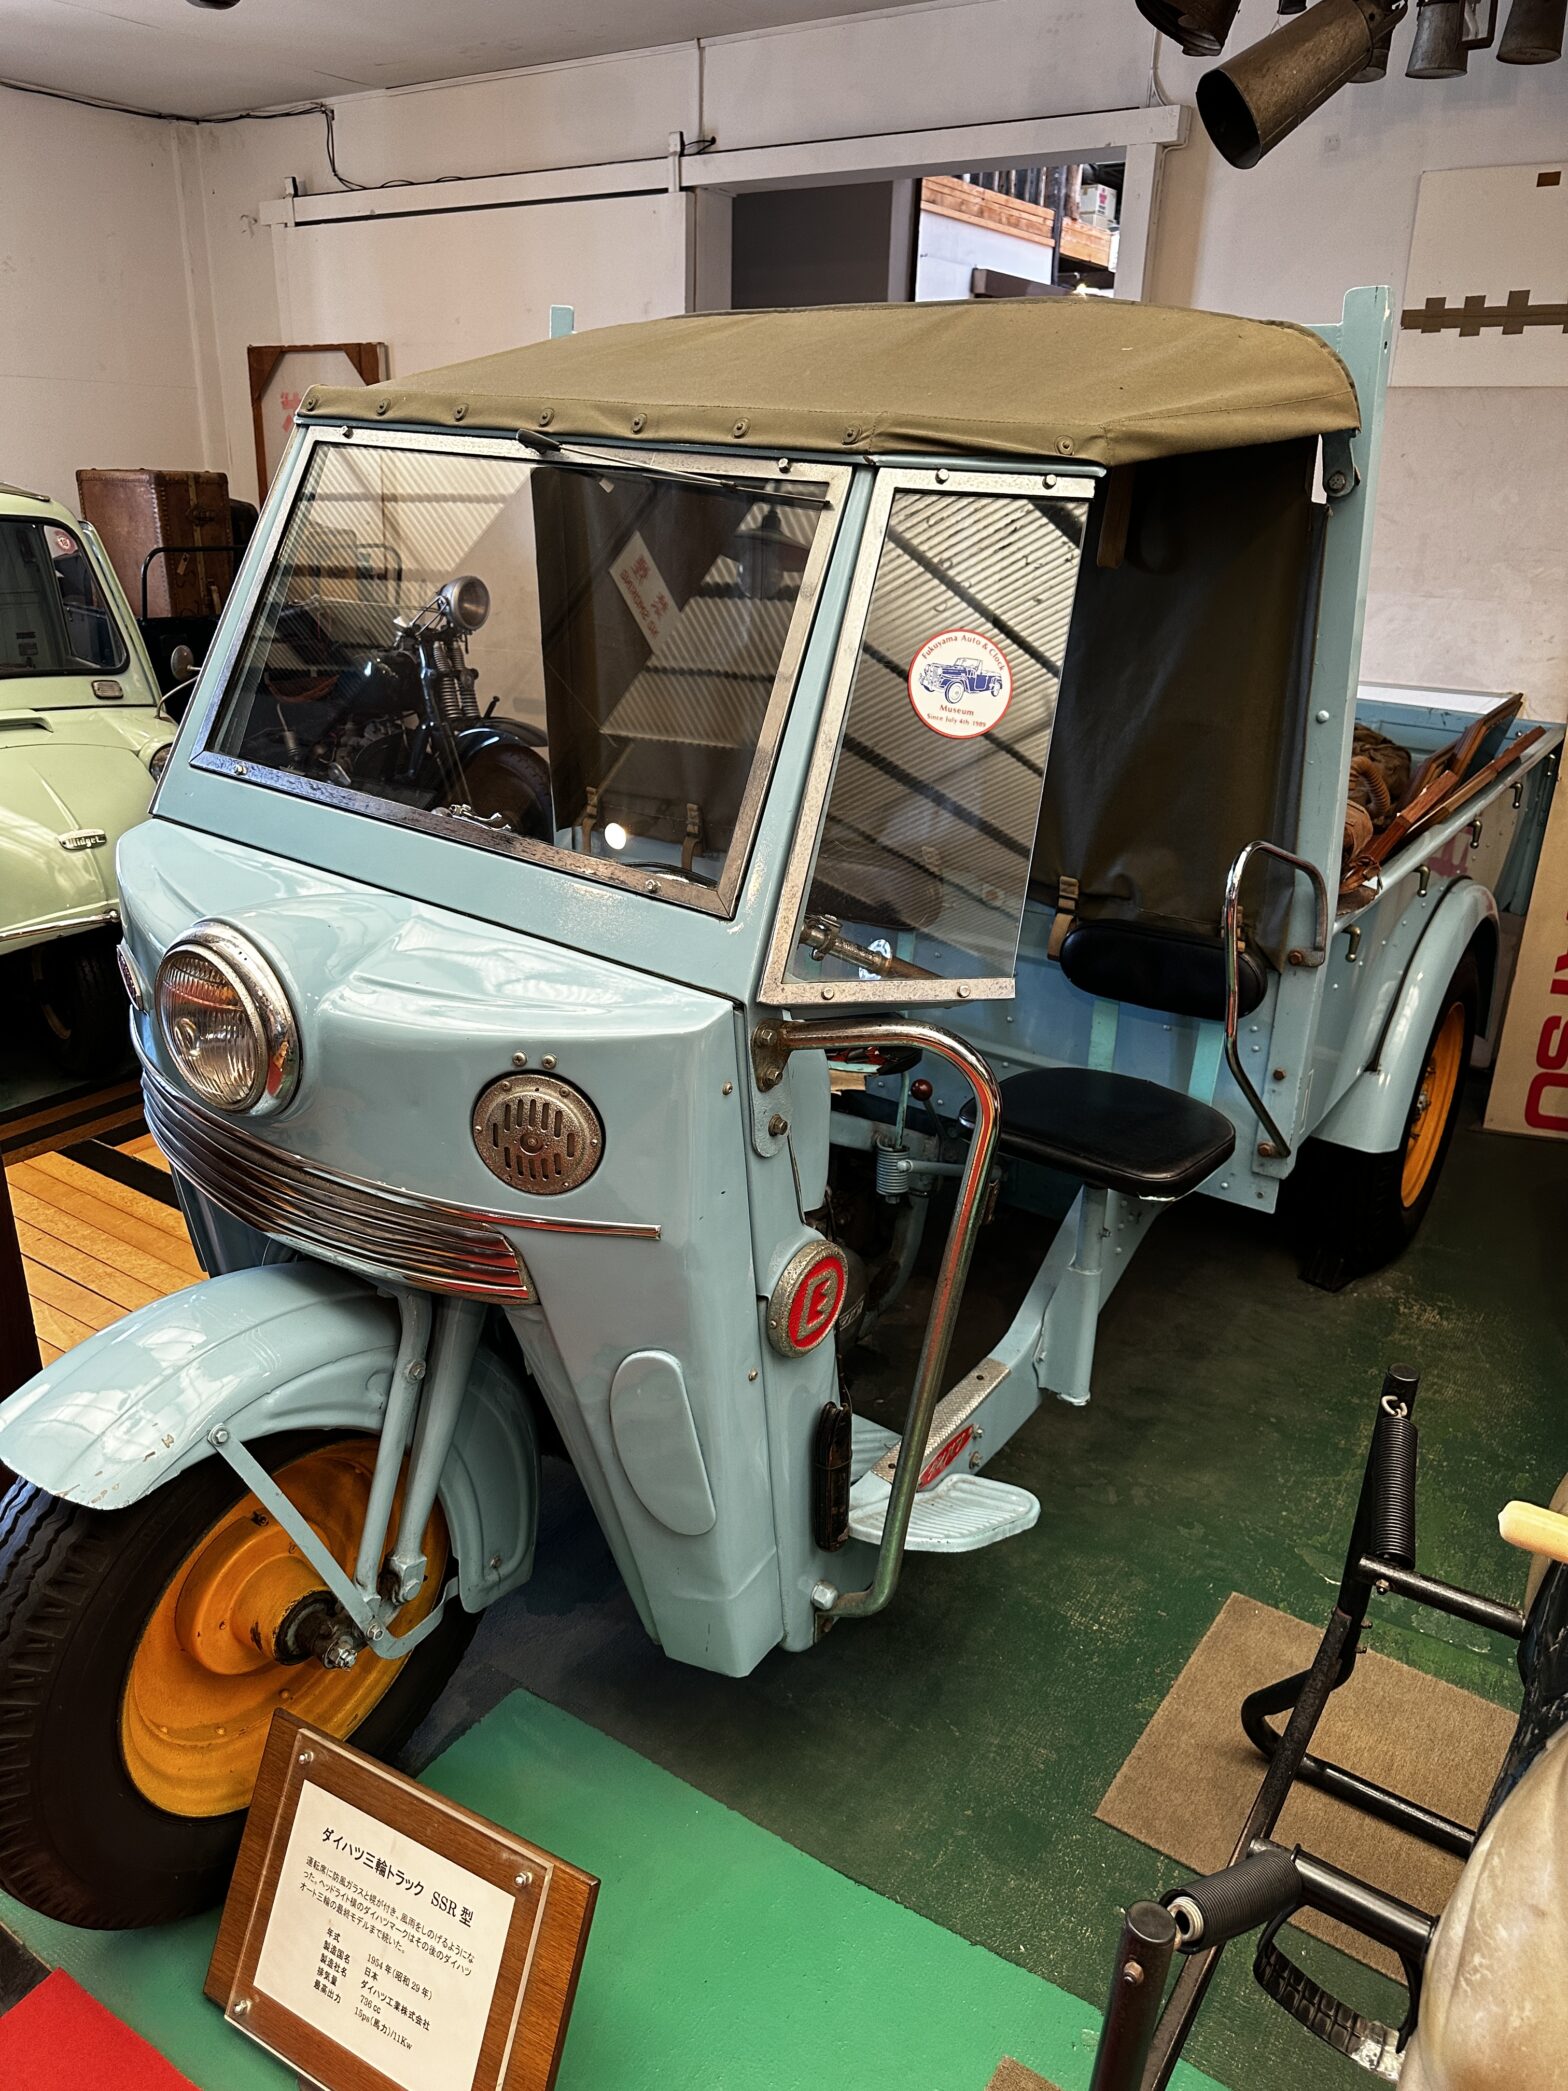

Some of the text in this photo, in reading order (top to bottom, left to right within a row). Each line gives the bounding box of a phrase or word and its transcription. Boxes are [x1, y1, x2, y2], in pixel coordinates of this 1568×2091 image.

[921, 634, 1006, 672] Fukuyama Auto & Clock
[926, 713, 944, 721] Since
[939, 704, 975, 716] Museum
[321, 1827, 474, 1928] ダイハツ三輪トラック SSR 型
[299, 1882, 405, 1954] オート三輪の最終モデルまで続いた。
[326, 1927, 341, 1944] 年式
[316, 1966, 338, 1987] 排気量
[322, 1939, 379, 1982] 製造国名 日本
[313, 1978, 342, 2005] 最高出力
[319, 1952, 431, 2031] 製造社名 ダイハツ工業株式会社
